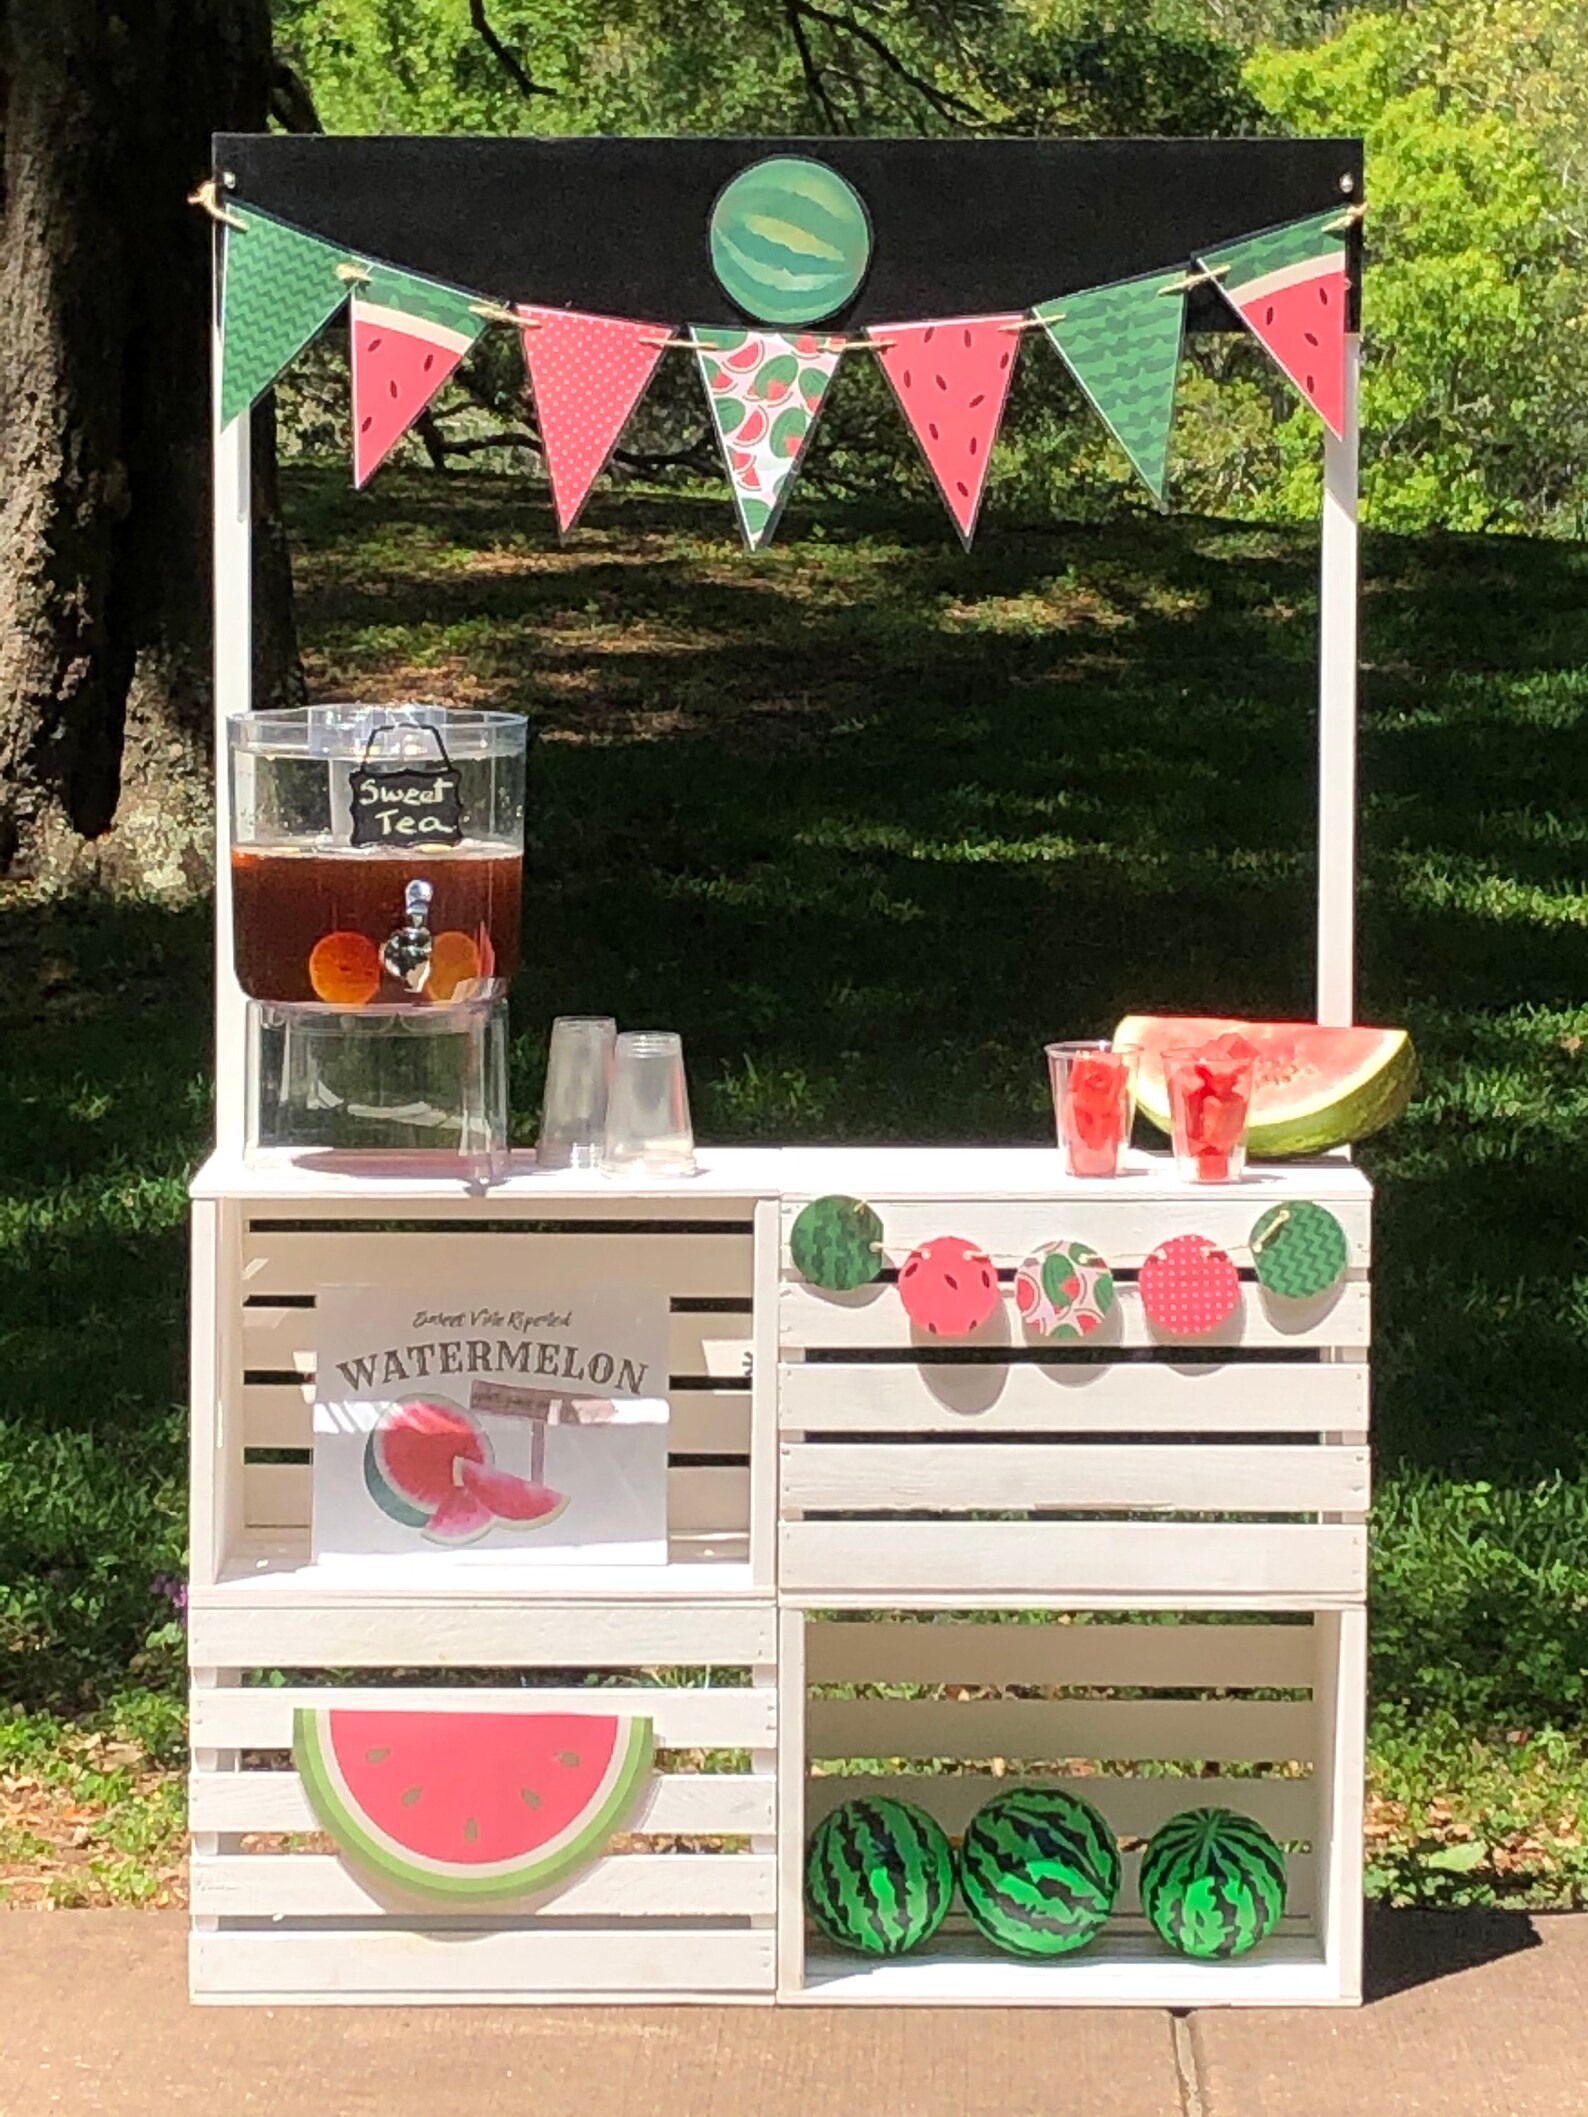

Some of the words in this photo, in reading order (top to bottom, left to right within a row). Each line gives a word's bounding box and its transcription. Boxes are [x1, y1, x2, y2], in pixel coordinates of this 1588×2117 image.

[360, 778, 454, 806] Sweet
[374, 808, 456, 835] Tea
[336, 1340, 649, 1395] WATERMELON
